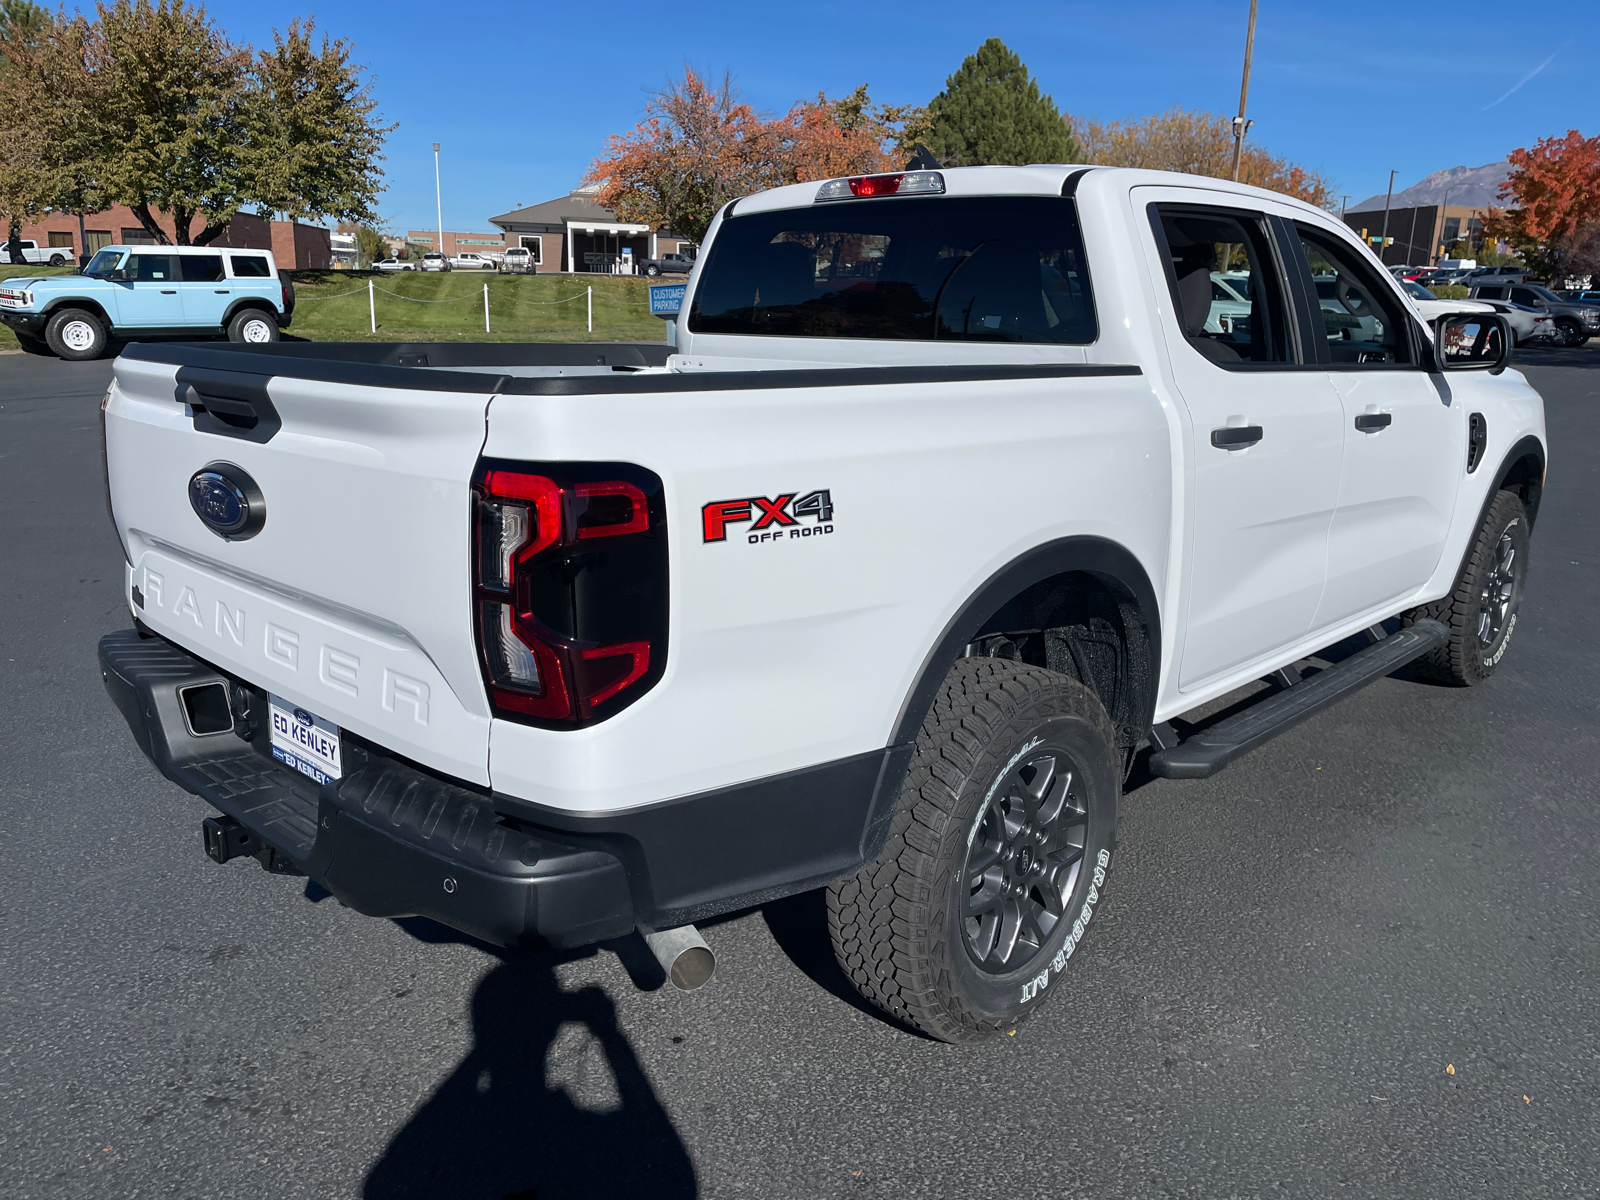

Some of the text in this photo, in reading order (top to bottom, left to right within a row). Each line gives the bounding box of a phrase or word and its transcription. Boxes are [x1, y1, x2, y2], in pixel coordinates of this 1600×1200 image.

[653, 288, 685, 300] CUSTOMER
[654, 300, 679, 310] PARKING
[700, 488, 834, 545] FX4
[748, 524, 834, 544] OFF ROAD
[142, 565, 431, 727] RANGER
[273, 712, 288, 735] ED
[291, 721, 336, 761] KENLEY
[297, 759, 326, 785] KENLEY
[1054, 848, 1110, 973] GRABBER
